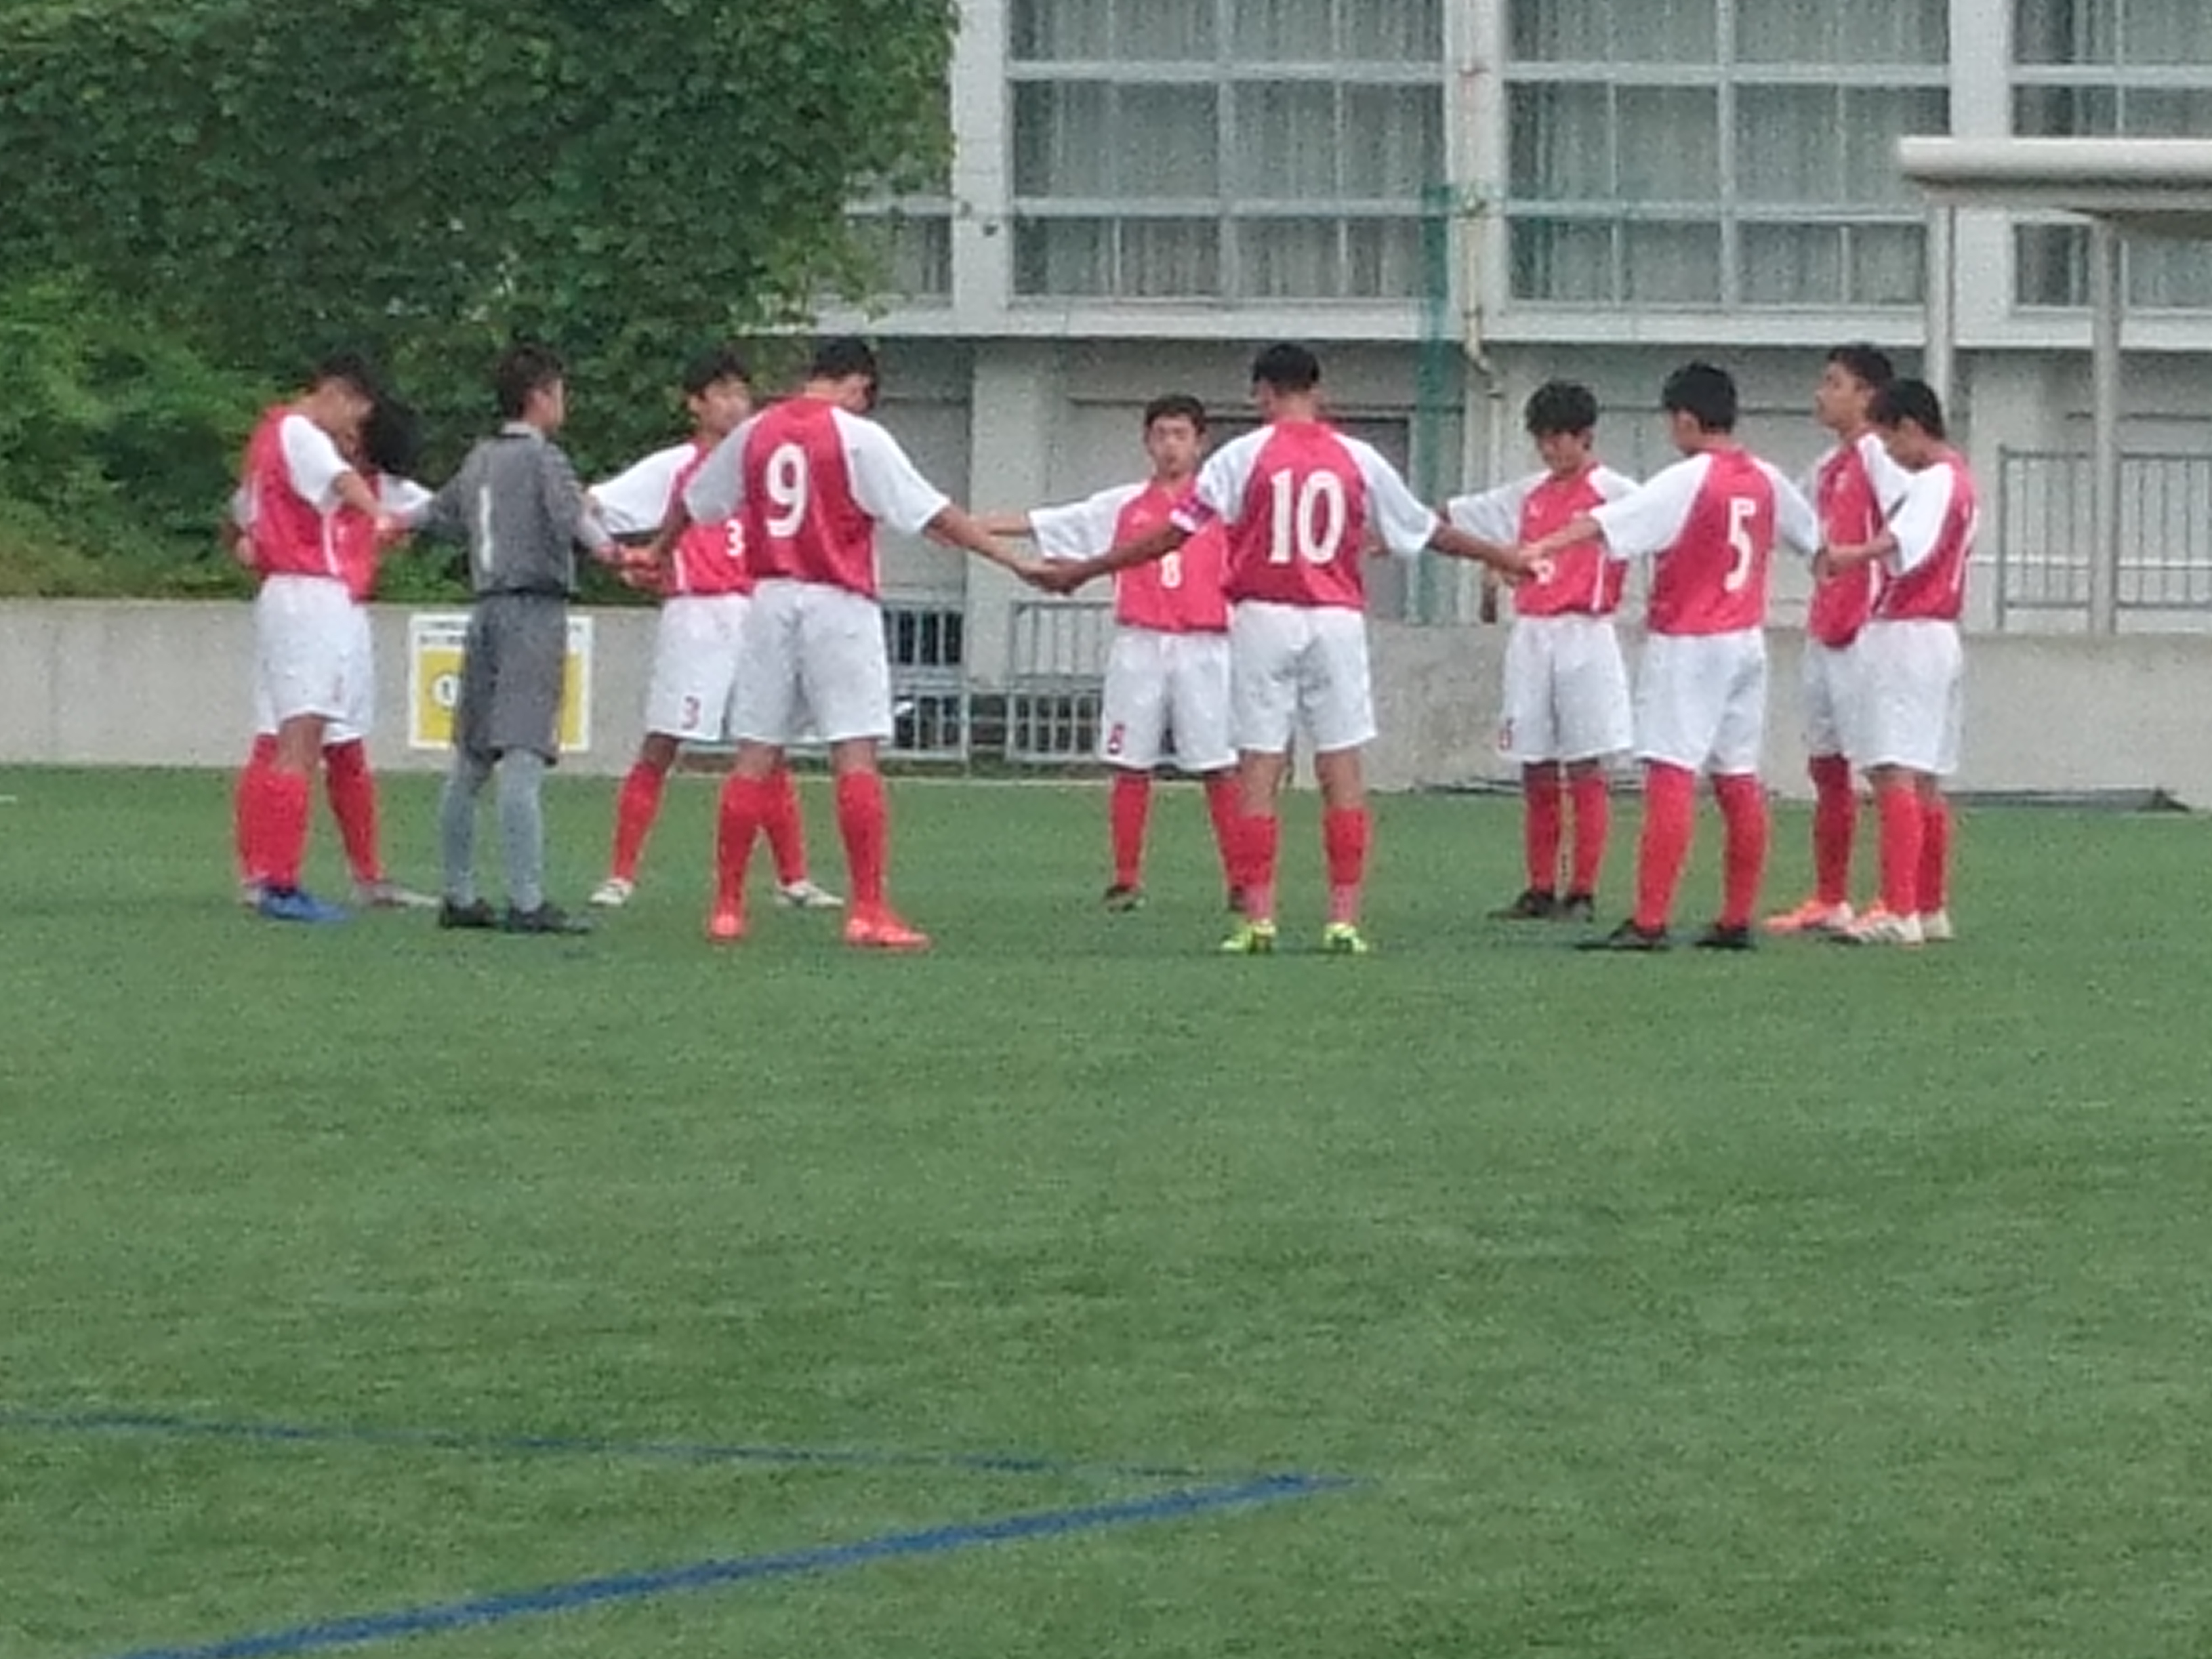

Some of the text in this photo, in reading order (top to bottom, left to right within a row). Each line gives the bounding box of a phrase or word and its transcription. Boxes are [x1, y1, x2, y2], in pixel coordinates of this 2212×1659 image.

[478, 486, 492, 570] 1
[766, 443, 808, 537] 9
[1267, 468, 1346, 564] 10
[726, 519, 745, 556] 3
[1161, 551, 1182, 588] 8
[1724, 497, 1757, 590] 5
[680, 695, 701, 730] 3
